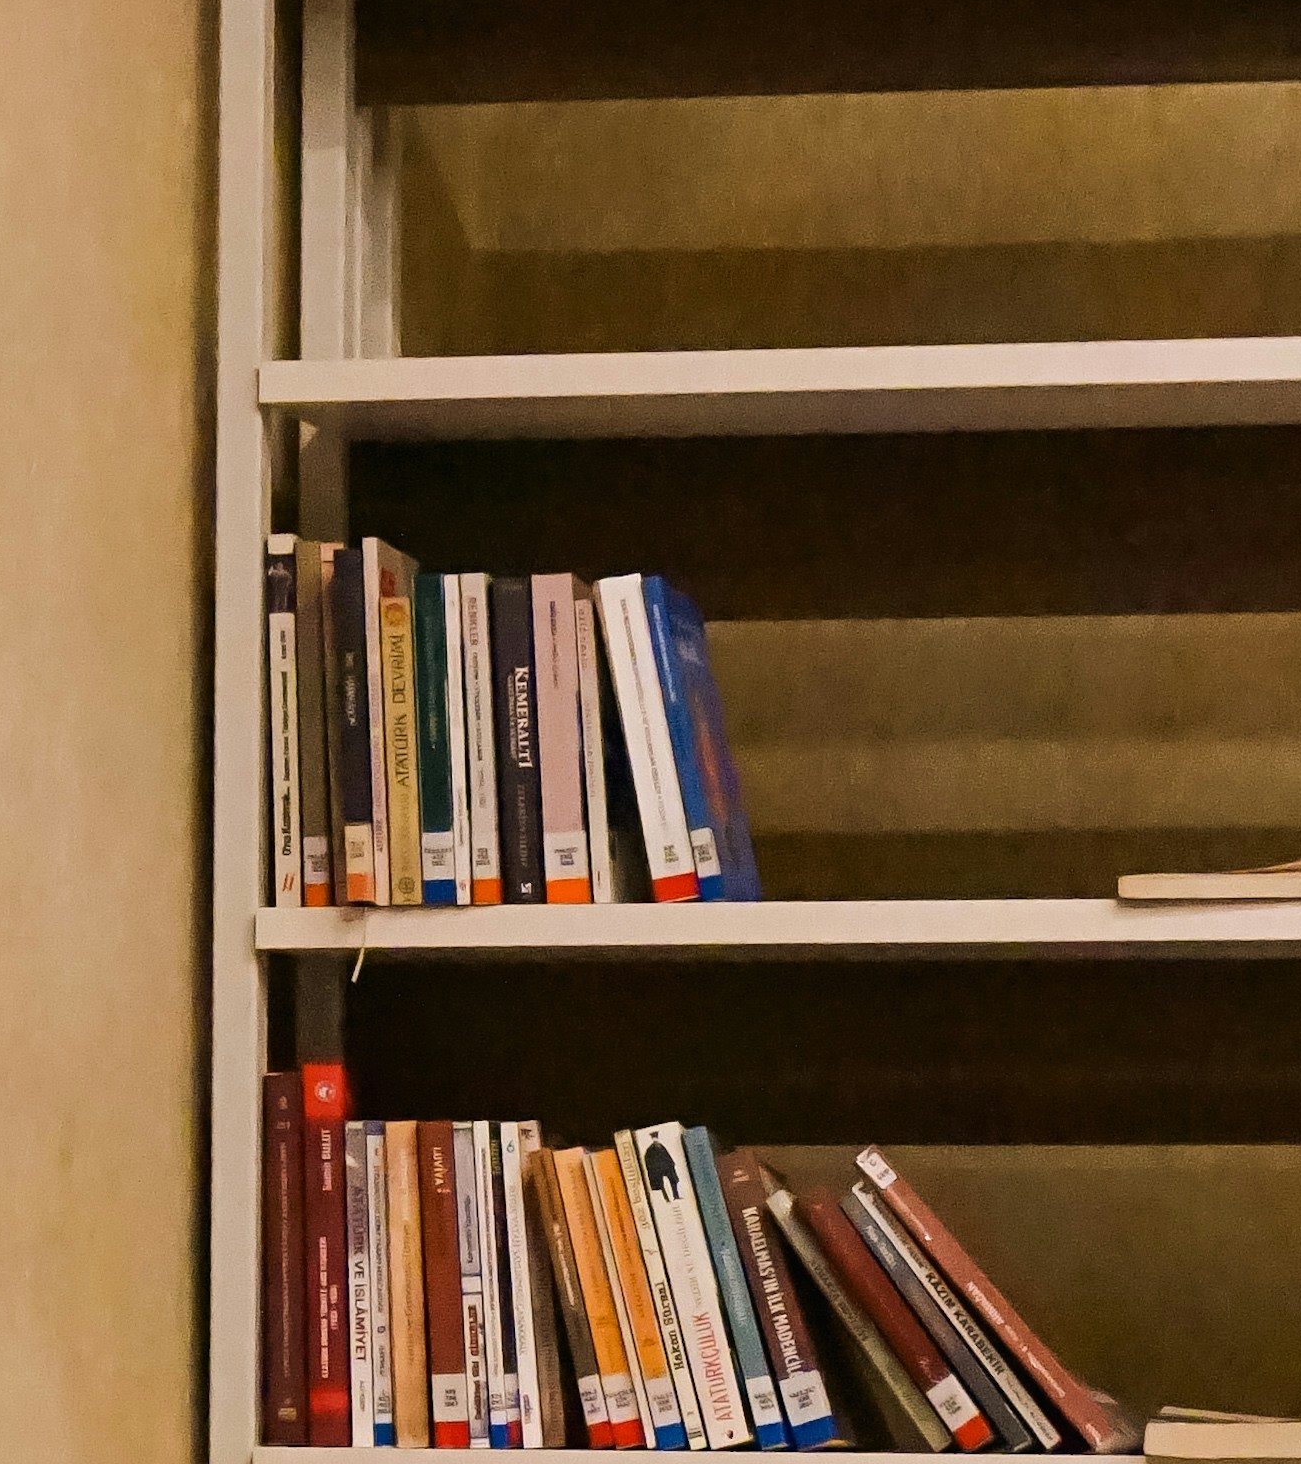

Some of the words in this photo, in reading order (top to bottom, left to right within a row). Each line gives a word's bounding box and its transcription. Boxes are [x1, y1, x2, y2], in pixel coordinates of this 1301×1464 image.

[514, 666, 533, 768] KEMERALTI
[395, 714, 409, 787] ATATÜRK
[321, 1128, 331, 1160] BULUT
[351, 1186, 367, 1255] ATATÜRK
[353, 1260, 366, 1280] VE
[669, 1328, 683, 1372] Hakan
